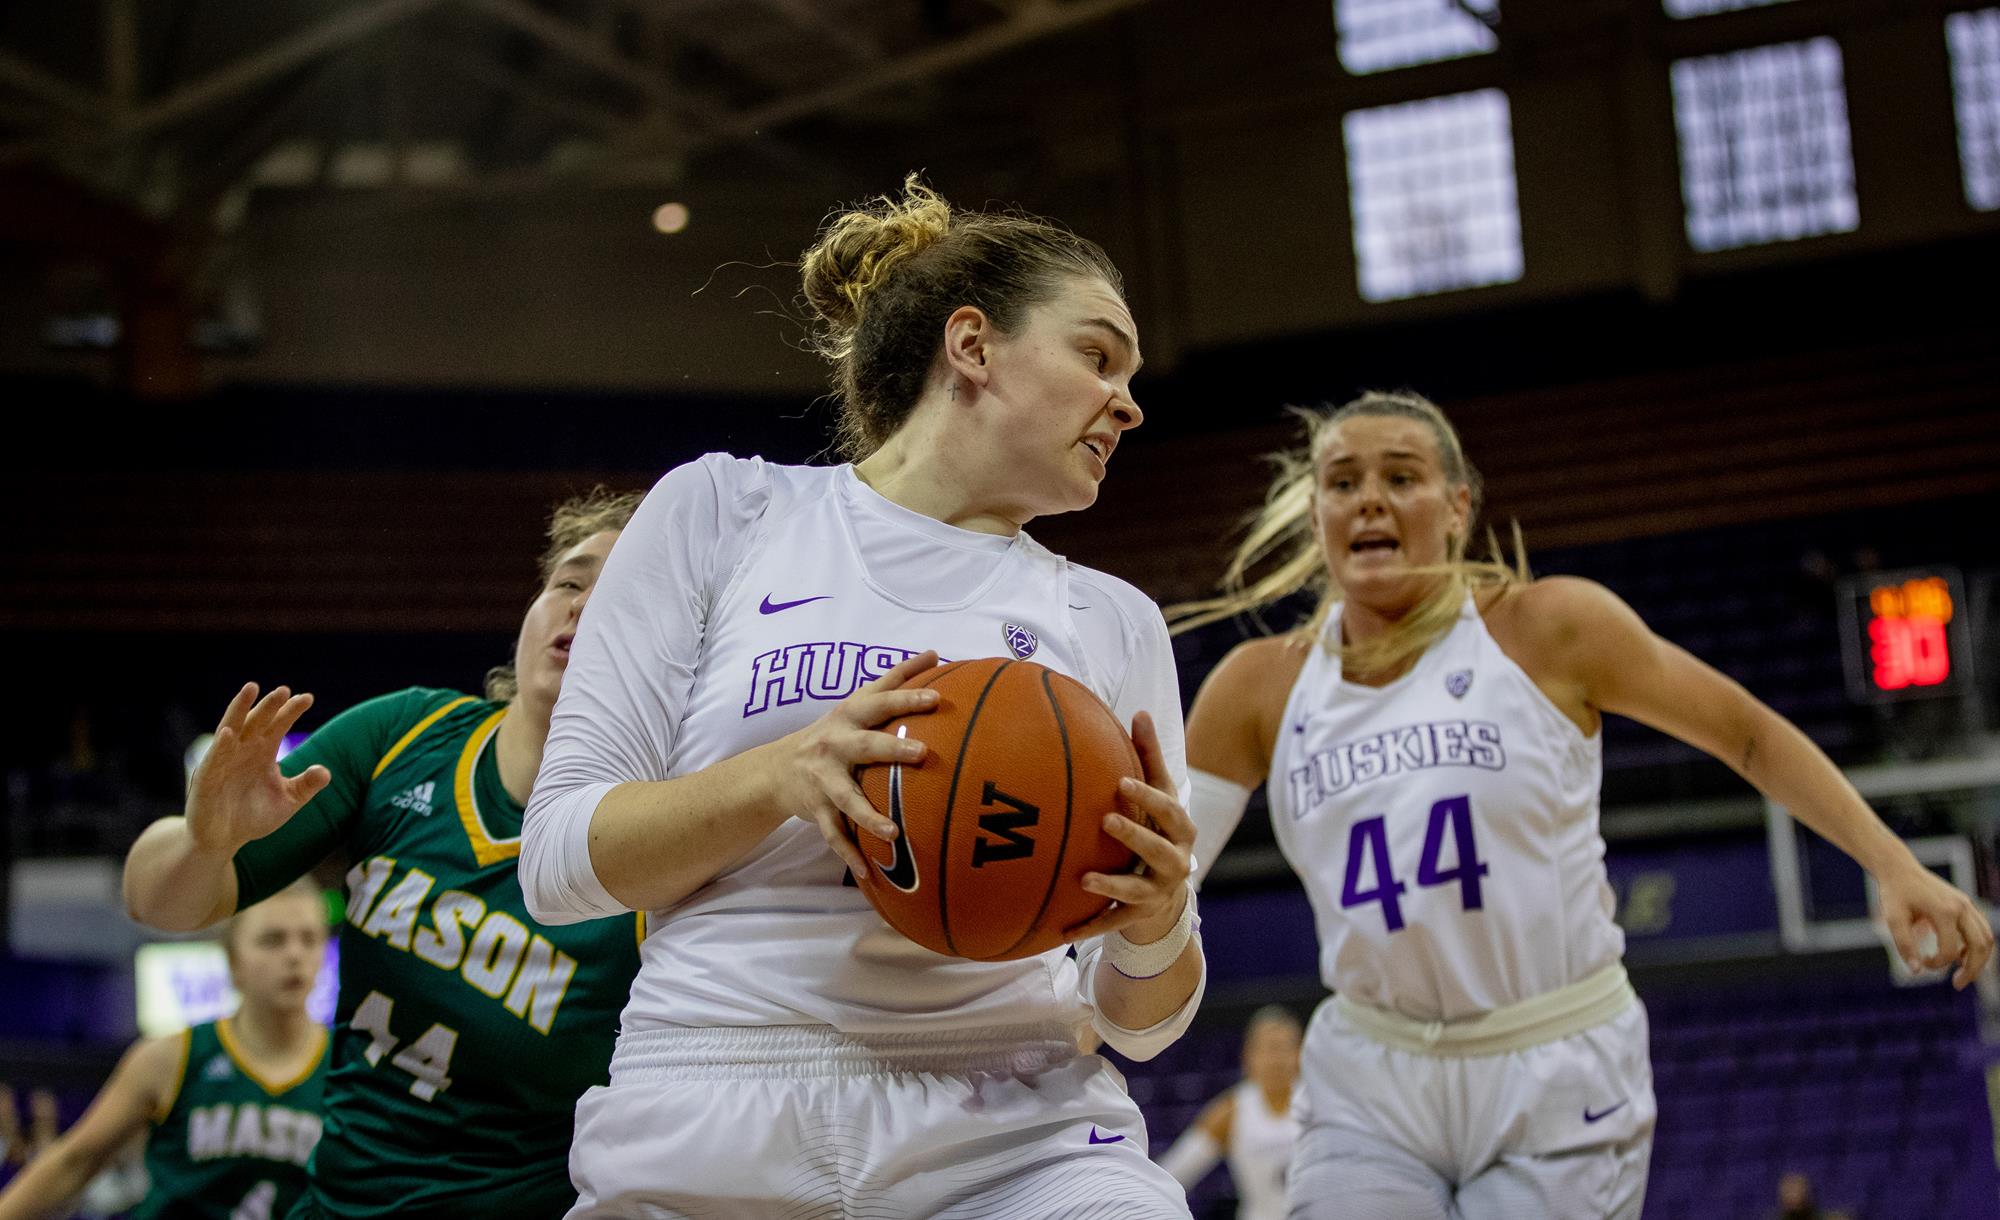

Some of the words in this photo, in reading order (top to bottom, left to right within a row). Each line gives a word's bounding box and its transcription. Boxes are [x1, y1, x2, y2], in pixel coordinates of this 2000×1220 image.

[743, 642, 921, 718] HUS
[1013, 637, 1029, 654] 12
[391, 795, 433, 817] adas
[1291, 721, 1506, 819] HUSKIES
[971, 781, 1041, 869] W
[1340, 793, 1489, 934] 44
